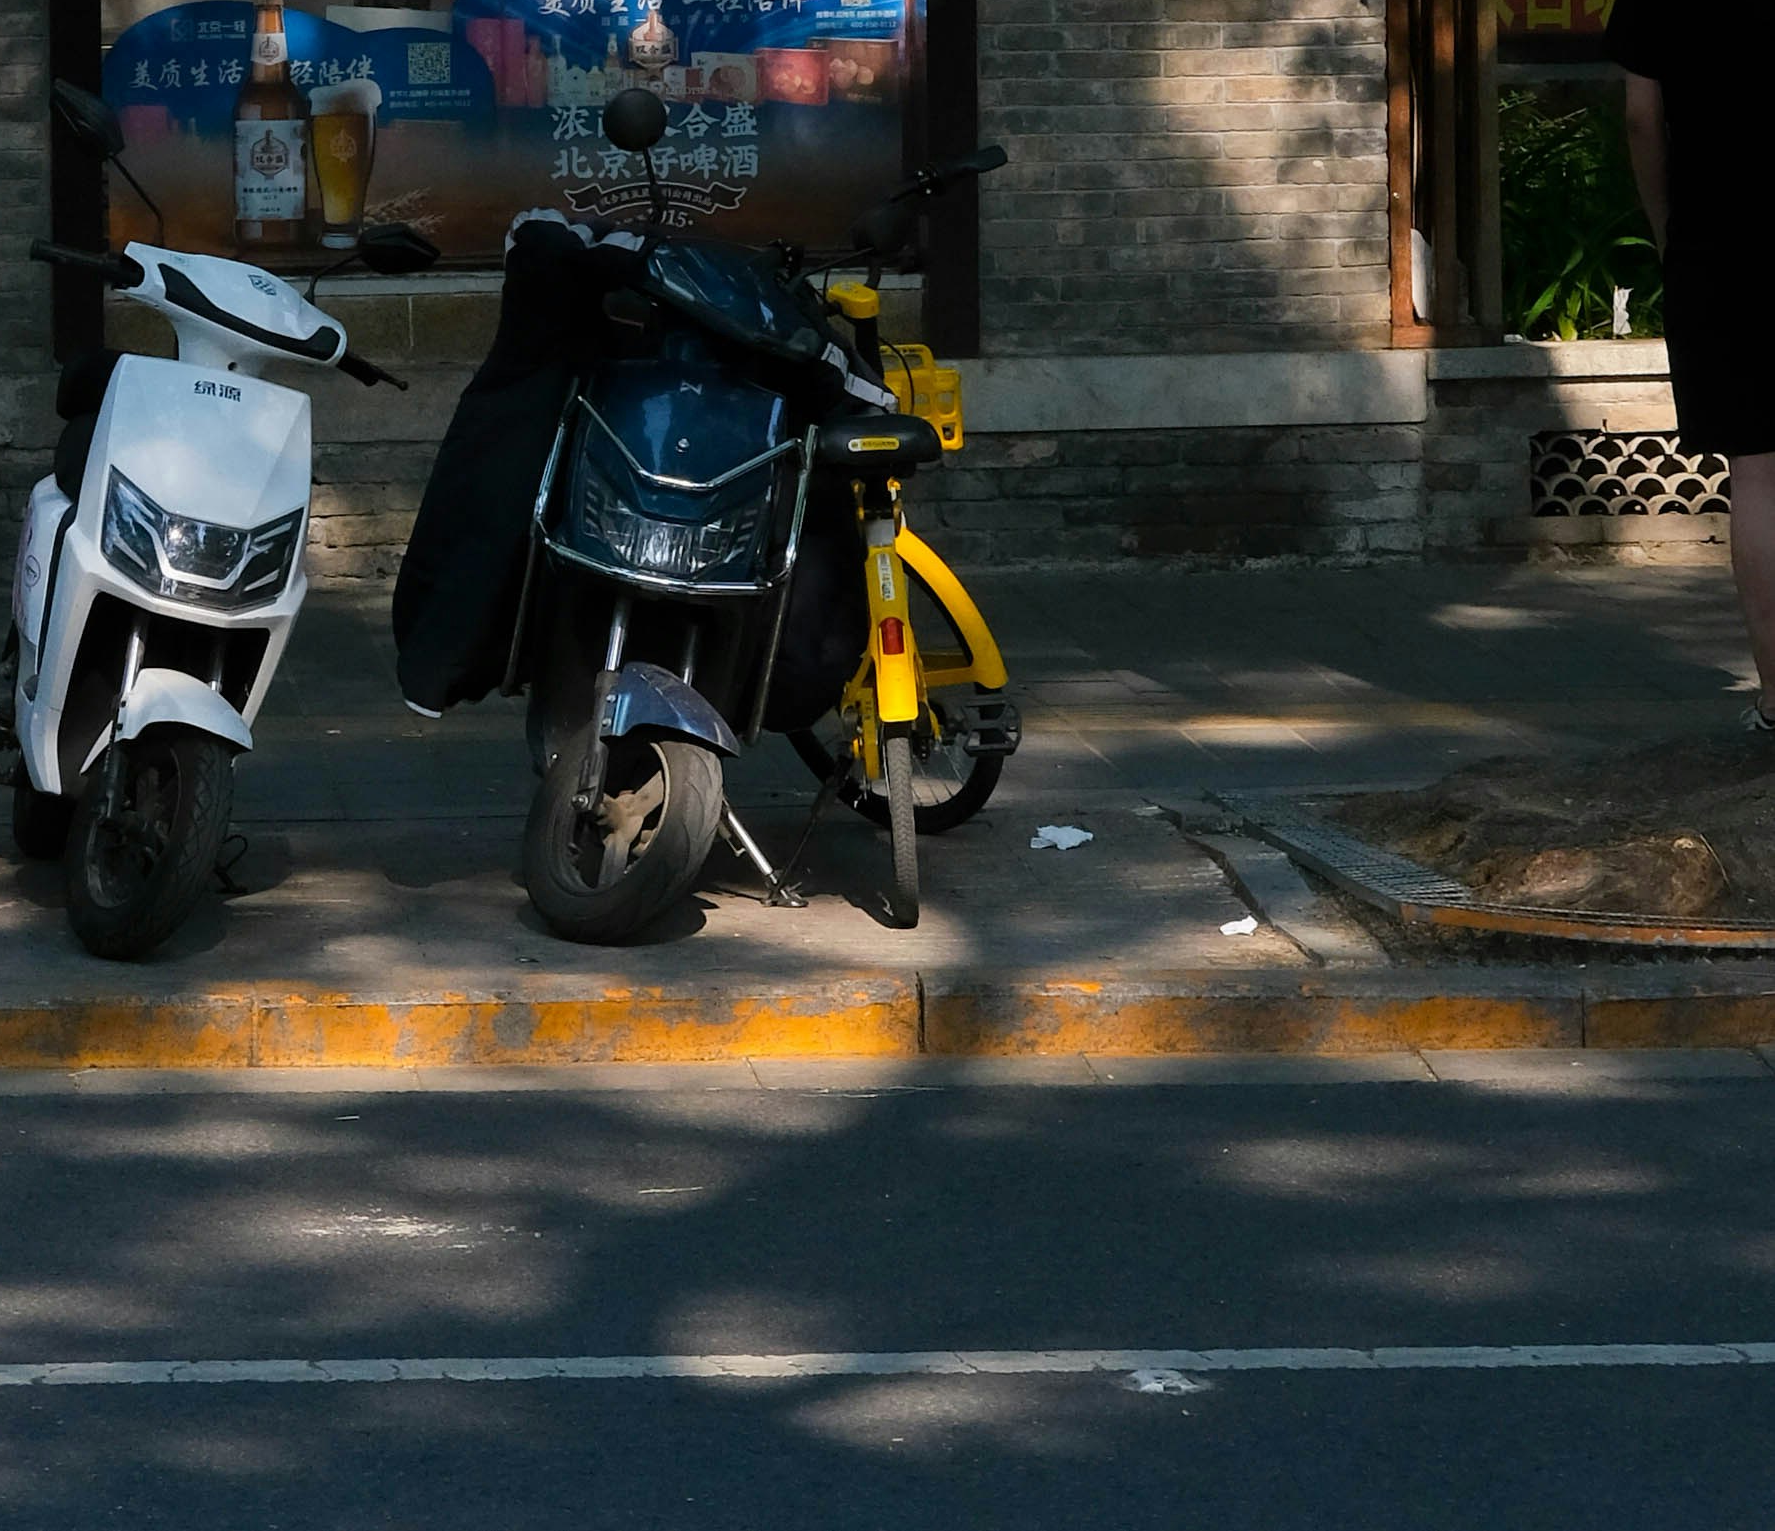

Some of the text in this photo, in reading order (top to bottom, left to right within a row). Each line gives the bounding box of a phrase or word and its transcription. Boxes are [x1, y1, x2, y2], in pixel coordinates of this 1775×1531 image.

[551, 101, 760, 141] 浓合盛
[551, 143, 760, 180] 北京好啤酒
